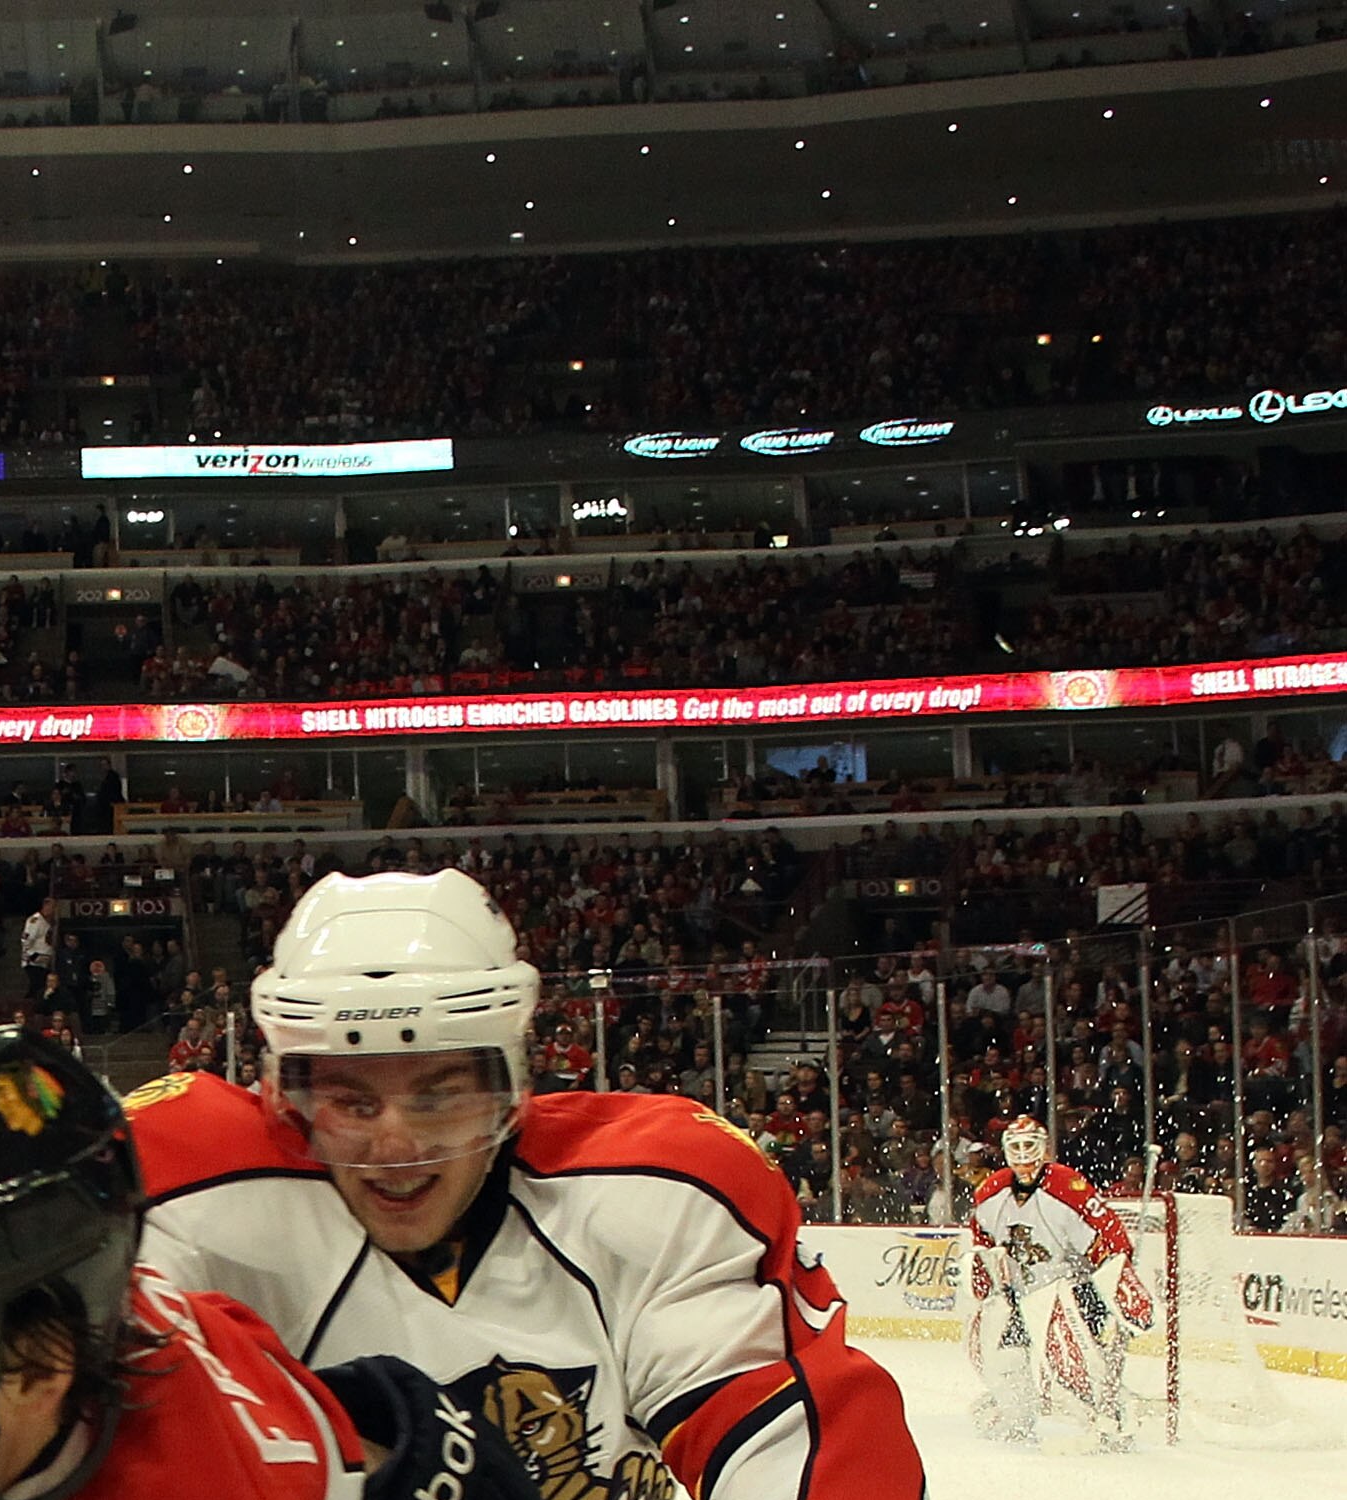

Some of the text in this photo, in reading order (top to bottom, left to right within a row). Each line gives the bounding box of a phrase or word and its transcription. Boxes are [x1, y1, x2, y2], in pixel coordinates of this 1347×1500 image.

[196, 446, 300, 475] verizon
[1190, 669, 1251, 696] SHELL
[301, 684, 982, 733] SHELL NITROGEN ENRICHED GASOLINES Get the most out of every drop!
[39, 713, 94, 740] drop!
